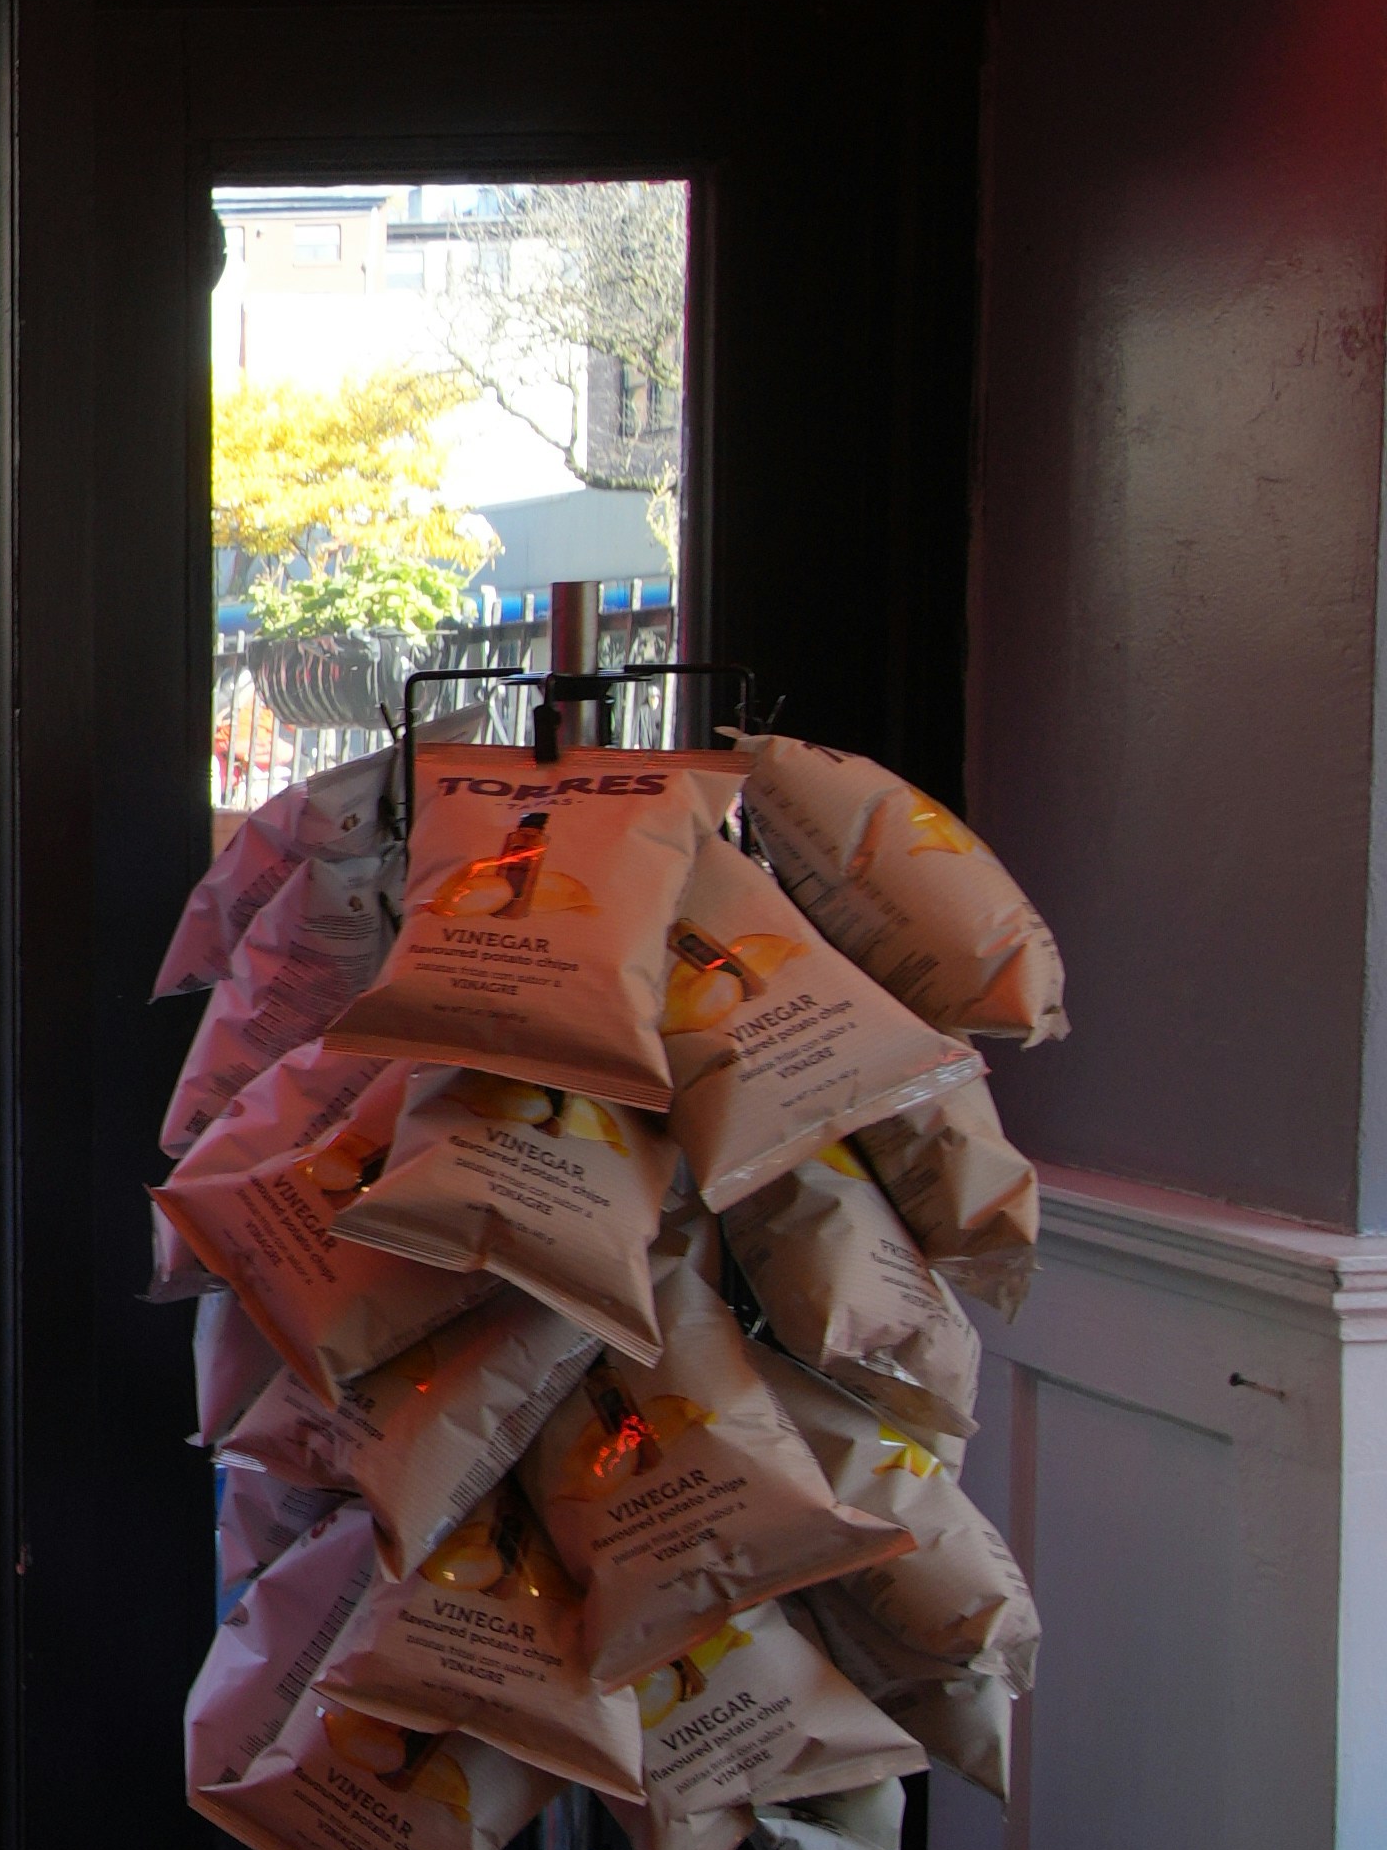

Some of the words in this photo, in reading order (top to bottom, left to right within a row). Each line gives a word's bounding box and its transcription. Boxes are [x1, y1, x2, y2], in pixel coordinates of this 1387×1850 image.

[437, 774, 669, 801] TORRES
[507, 798, 573, 811] TAPAS
[409, 943, 477, 960] flavoured
[482, 949, 533, 966] potato
[535, 956, 580, 972] chips
[442, 927, 551, 953] VINEGAR
[450, 977, 519, 996] VINAGRE
[724, 994, 820, 1042] VINEGAR
[777, 1016, 820, 1043] potato
[819, 1000, 854, 1020] chips
[776, 1046, 836, 1079] VINAGRE
[449, 1134, 519, 1167] flavoured
[519, 1161, 571, 1190] potato
[570, 1183, 612, 1208] chips
[485, 1126, 587, 1182] VINEGAR
[271, 1173, 339, 1253] VINEGAR
[486, 1180, 555, 1217] VINAGRE
[606, 1468, 711, 1524] VINEGAR
[657, 1494, 707, 1525] potato
[706, 1475, 749, 1500] chips
[652, 1527, 719, 1562] VINAGRE
[398, 1608, 467, 1640] flavoured
[468, 1630, 520, 1655] potato
[521, 1647, 565, 1668] chips
[433, 1599, 538, 1643] VINEGAR
[439, 1656, 507, 1686] VINAGRE
[649, 1738, 715, 1783] flavoured
[713, 1716, 758, 1750] potato
[756, 1695, 794, 1721] chips
[659, 1691, 758, 1752] VINEGAR
[711, 1748, 774, 1787] VINAGRE
[326, 1766, 414, 1840] VINEGAR
[348, 1807, 394, 1844] potato
